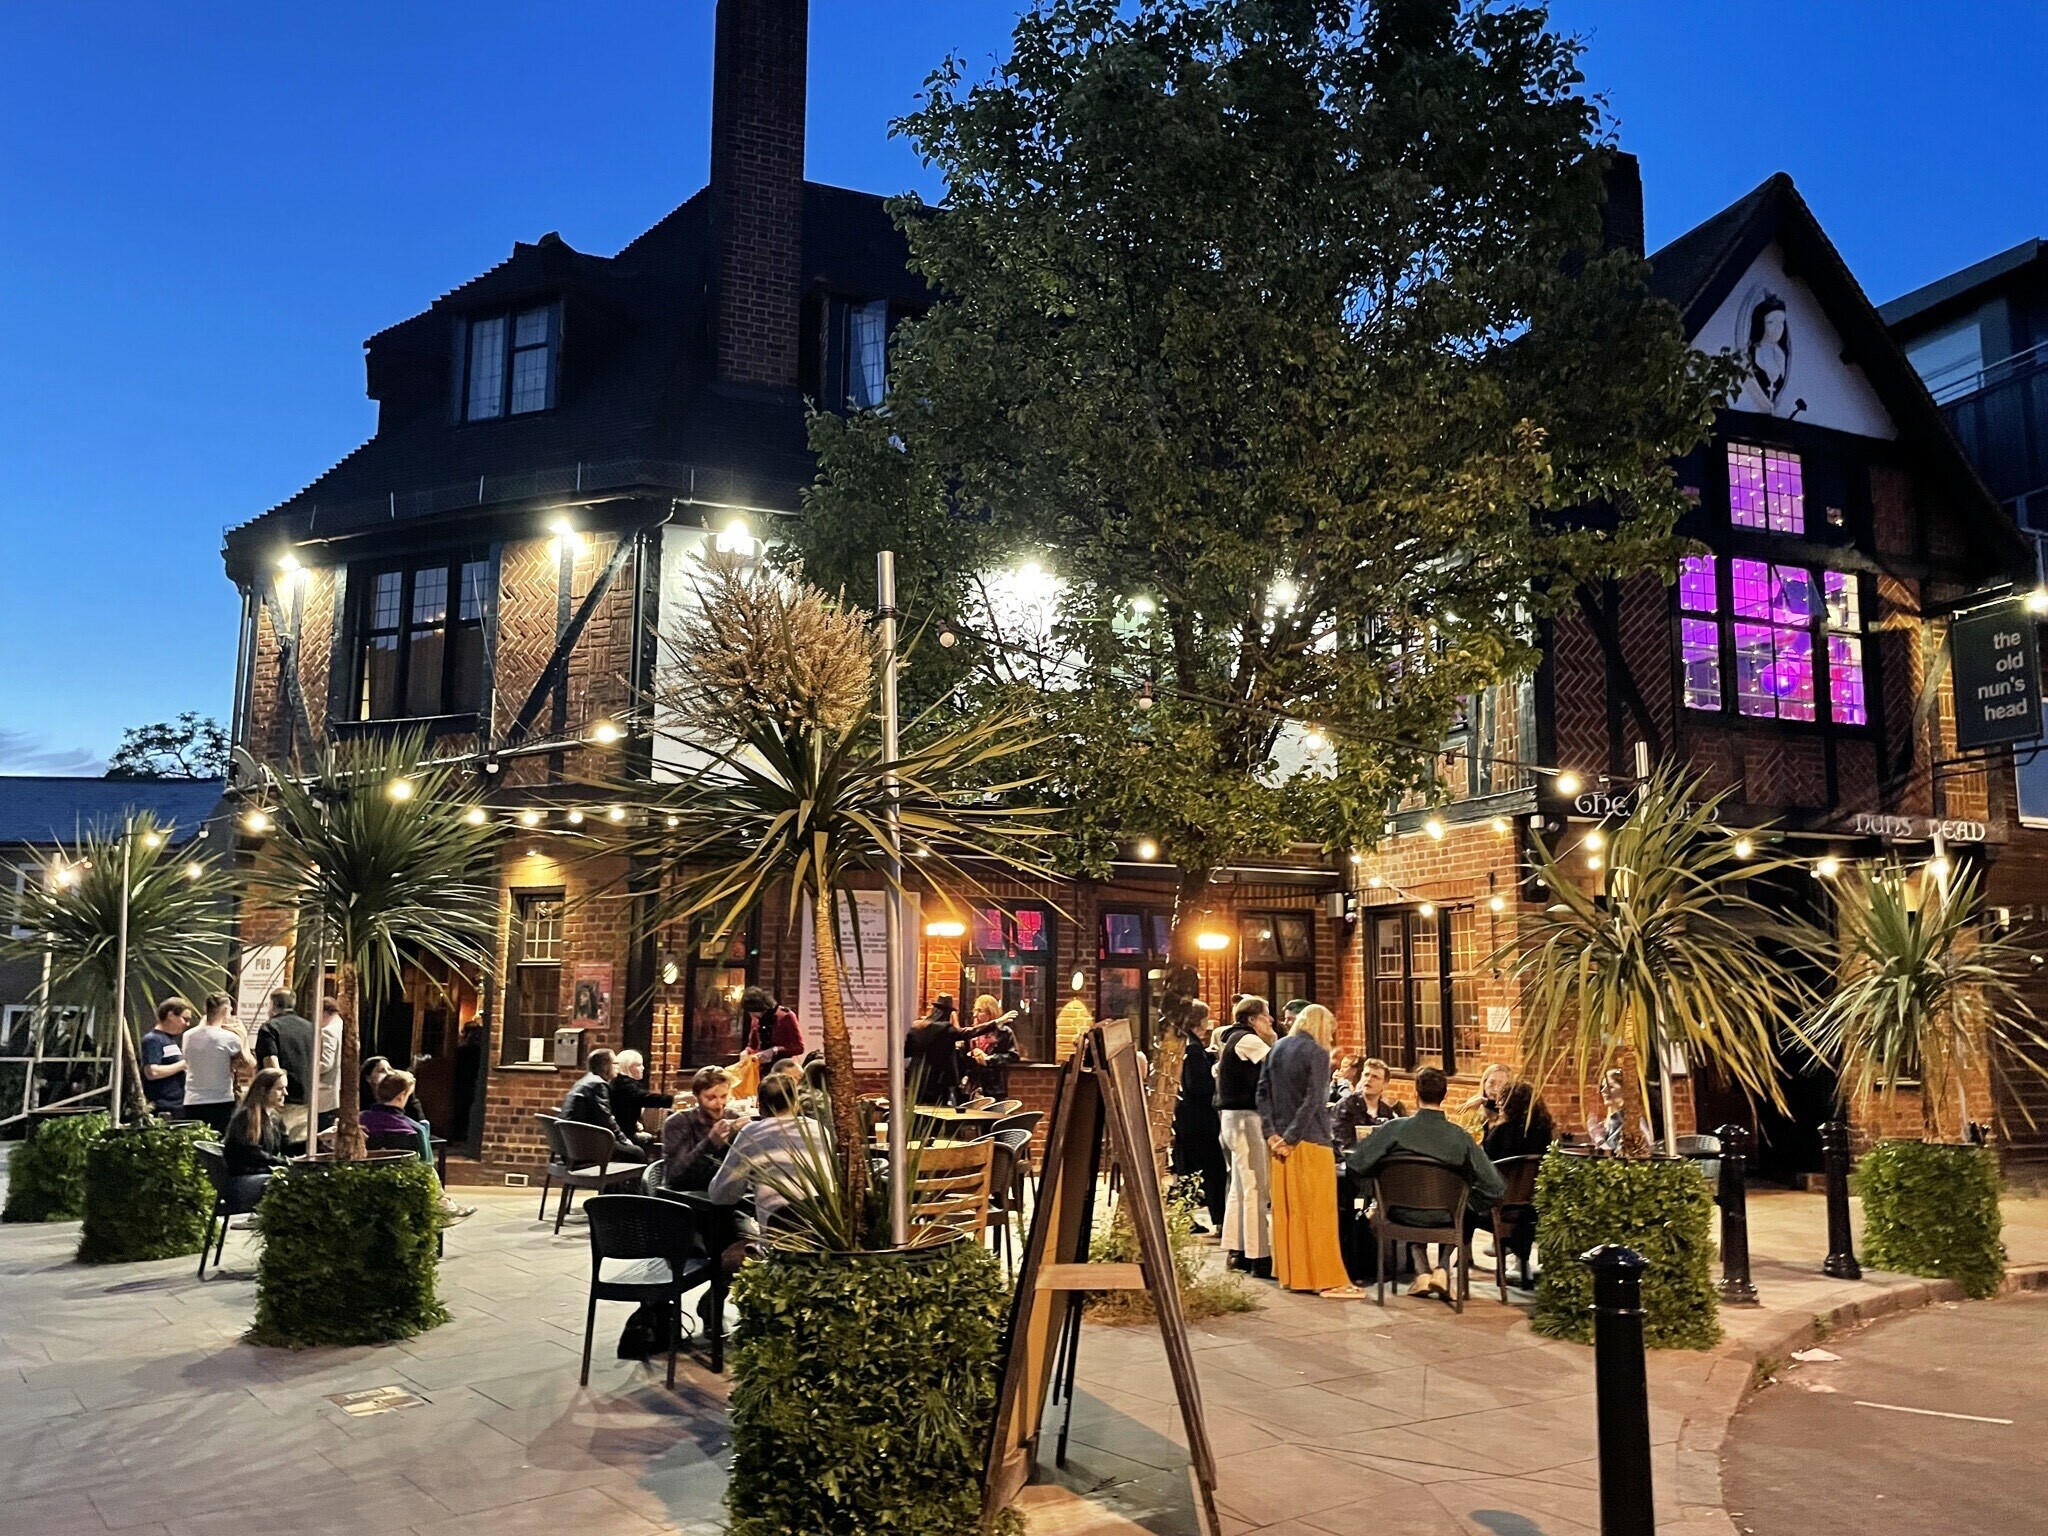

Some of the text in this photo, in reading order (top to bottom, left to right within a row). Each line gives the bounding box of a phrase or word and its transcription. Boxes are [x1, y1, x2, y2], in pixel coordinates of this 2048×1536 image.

[1993, 632, 2021, 650] the
[1996, 651, 2024, 672] old
[1977, 676, 2026, 699] nun's
[1984, 698, 2028, 721] head
